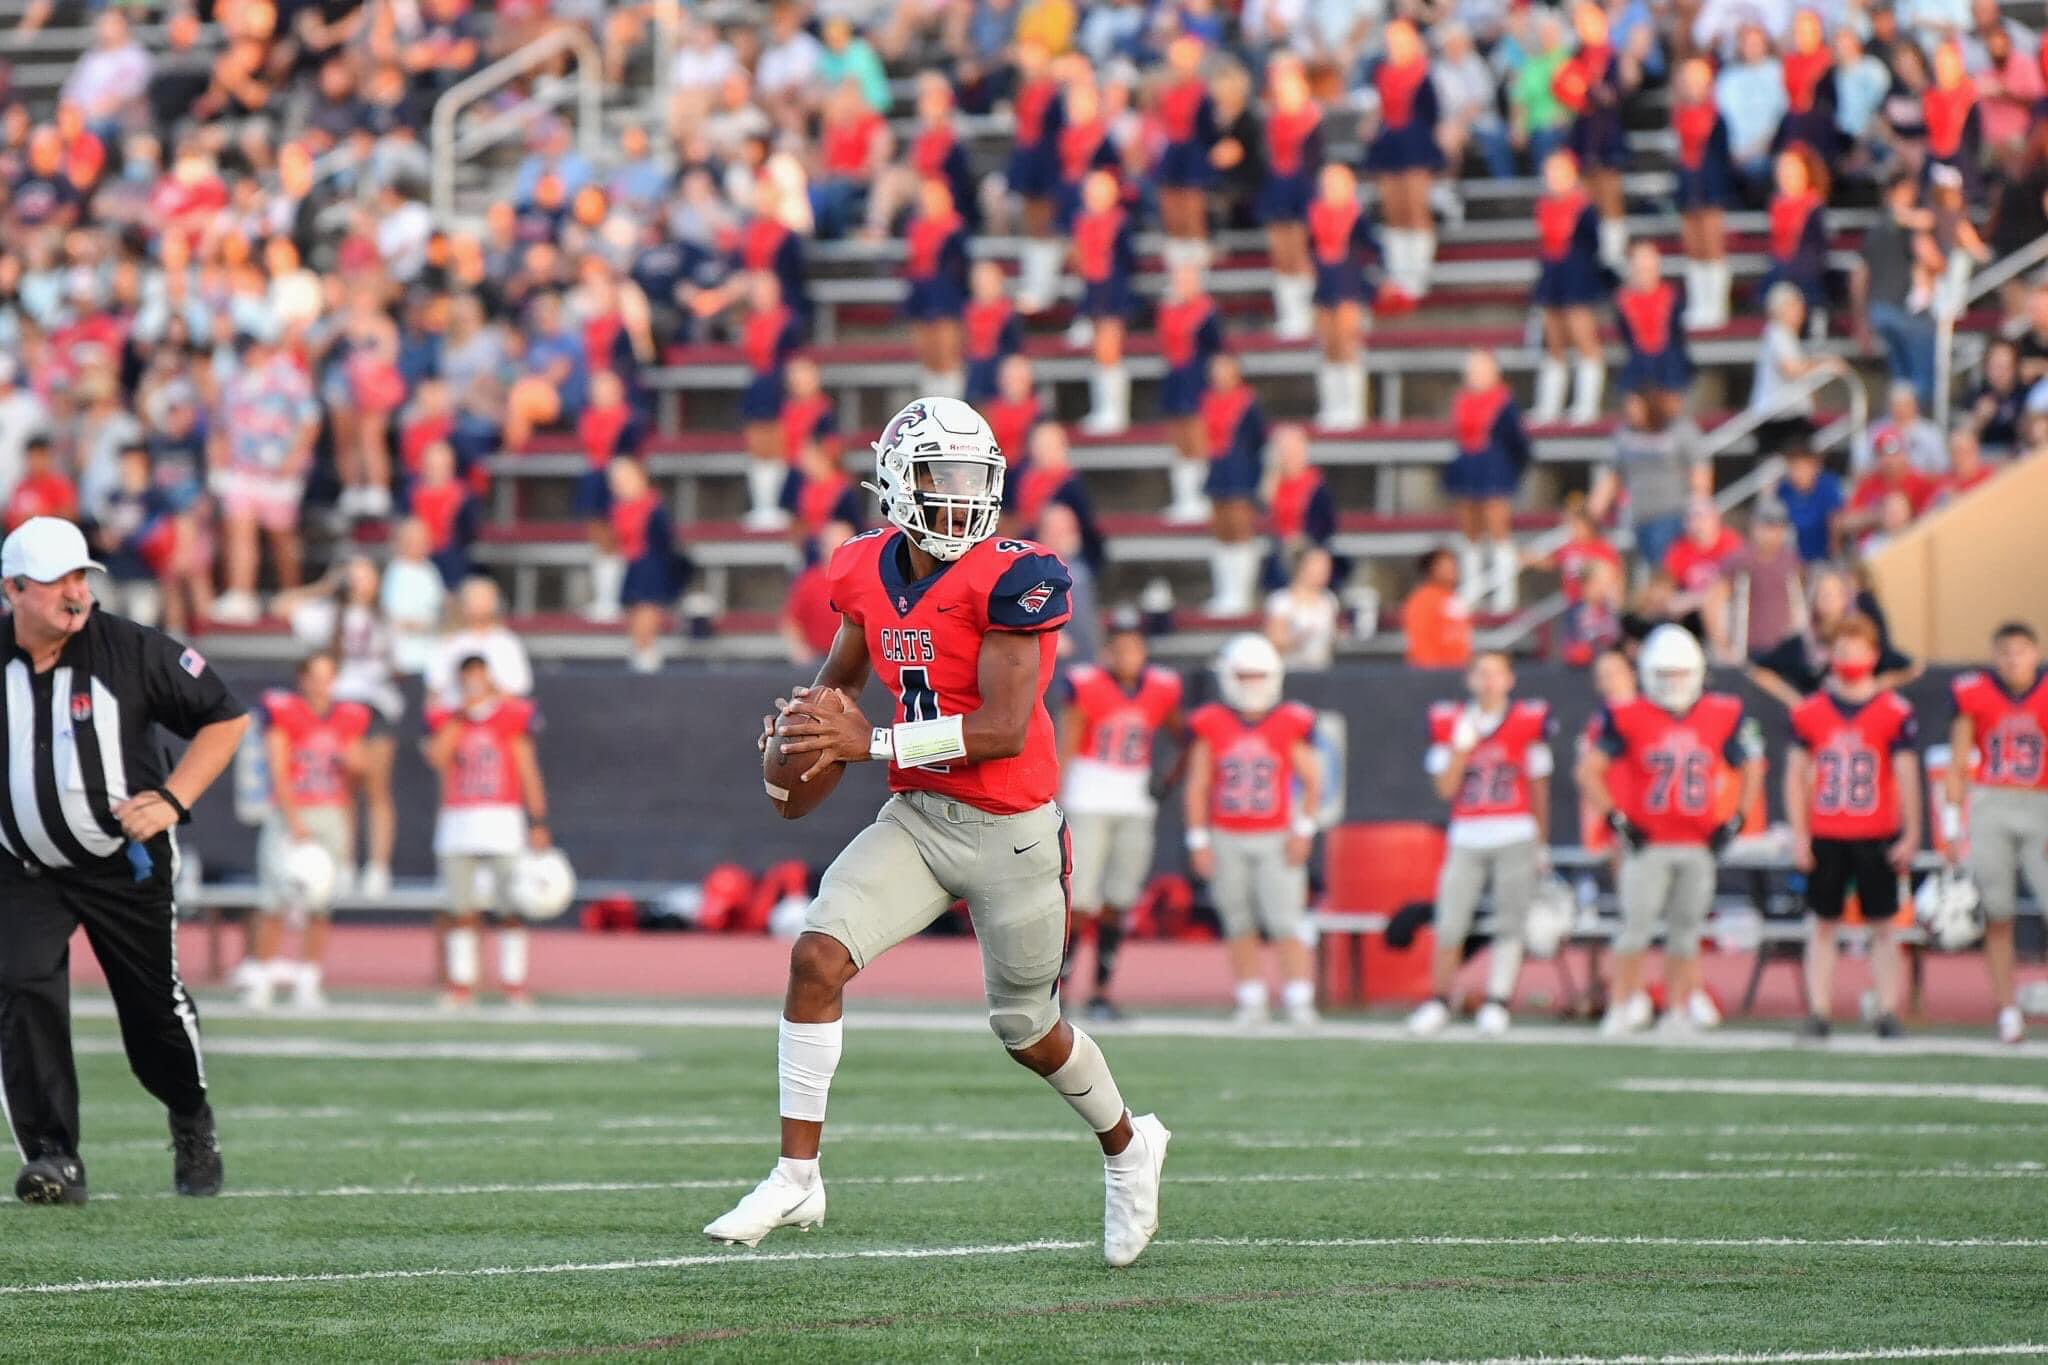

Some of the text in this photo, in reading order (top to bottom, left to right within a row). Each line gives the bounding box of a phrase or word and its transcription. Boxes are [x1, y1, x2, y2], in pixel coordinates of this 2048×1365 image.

[881, 628, 935, 661] CATS
[900, 666, 950, 773] 4
[1647, 748, 1712, 812] 76
[1816, 750, 1880, 814] 38
[1985, 732, 2046, 782] 13
